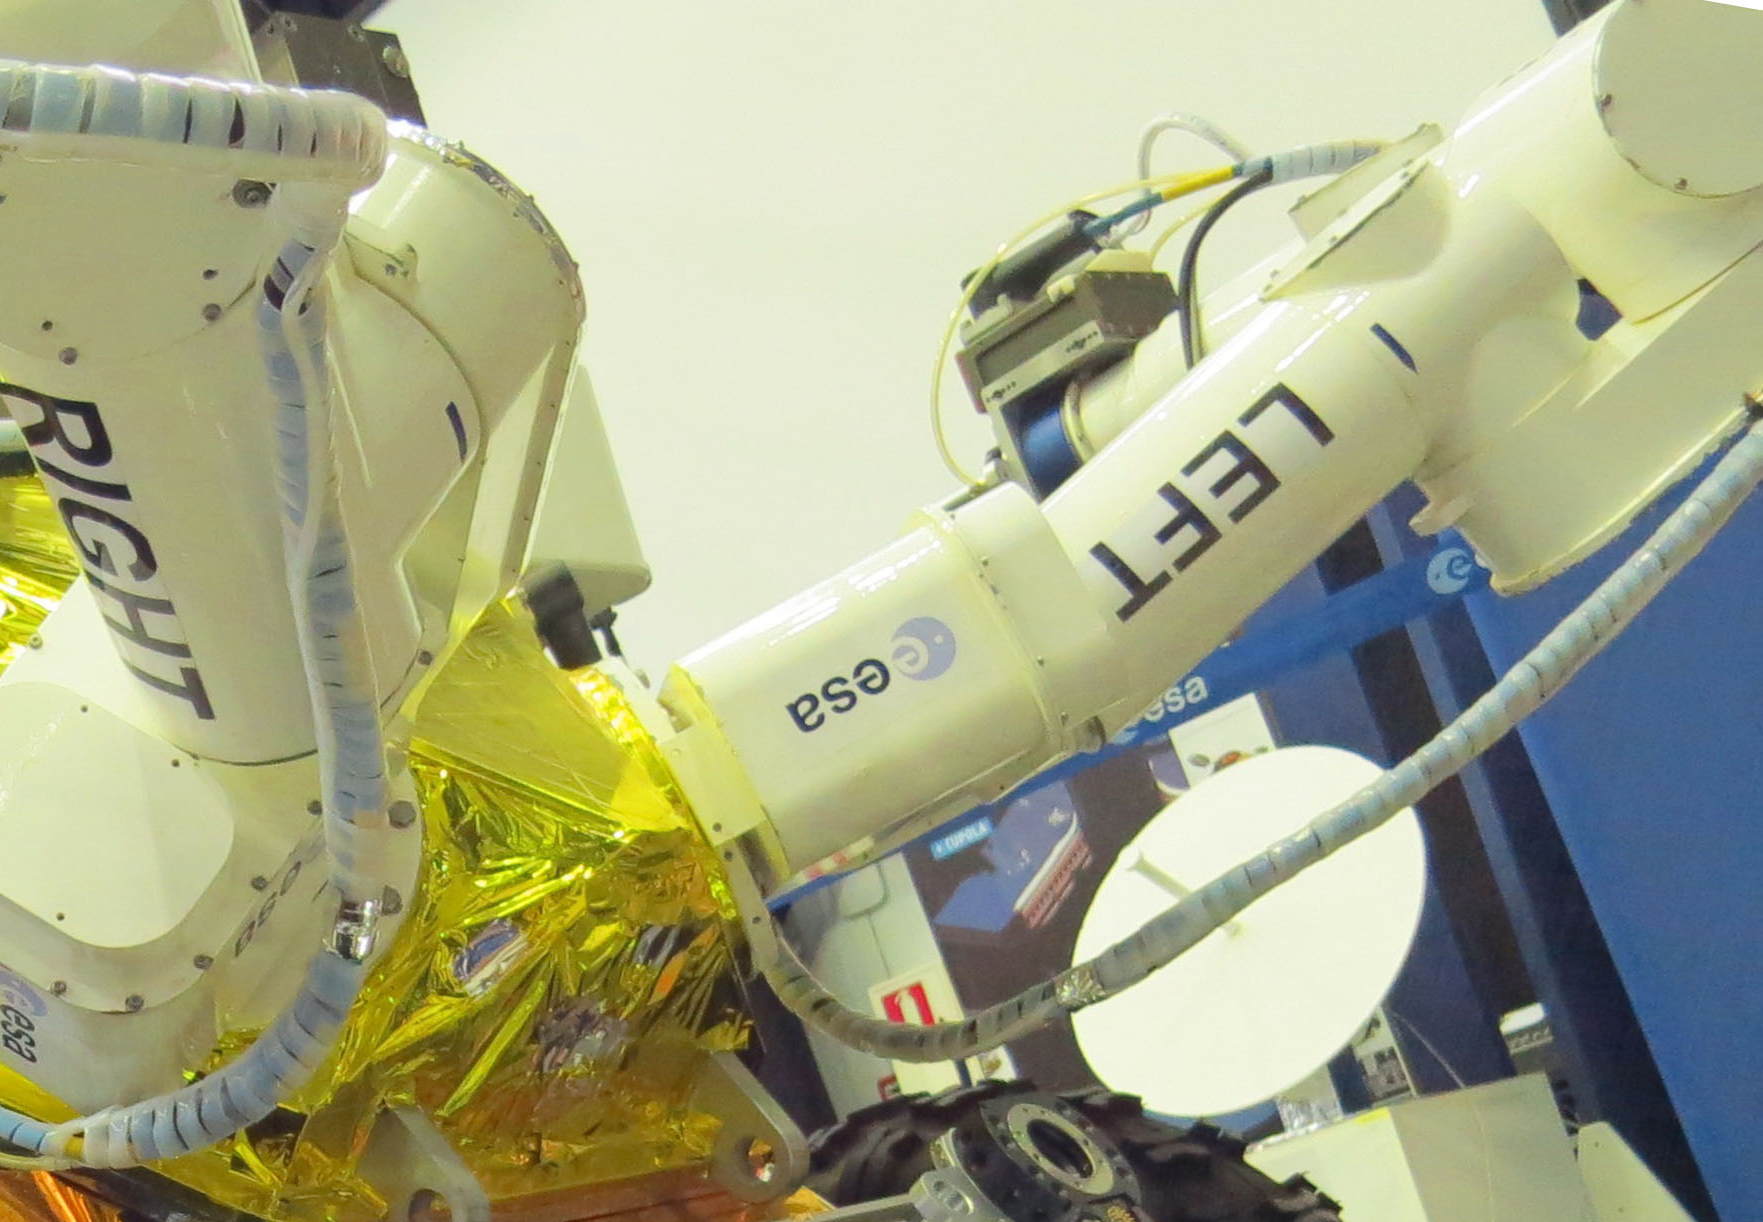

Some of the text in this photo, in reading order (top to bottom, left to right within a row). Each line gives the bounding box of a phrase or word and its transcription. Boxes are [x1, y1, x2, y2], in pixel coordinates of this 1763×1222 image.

[1088, 382, 1335, 623] LEFT
[785, 659, 891, 733] esa
[0, 1004, 37, 1063] esa
